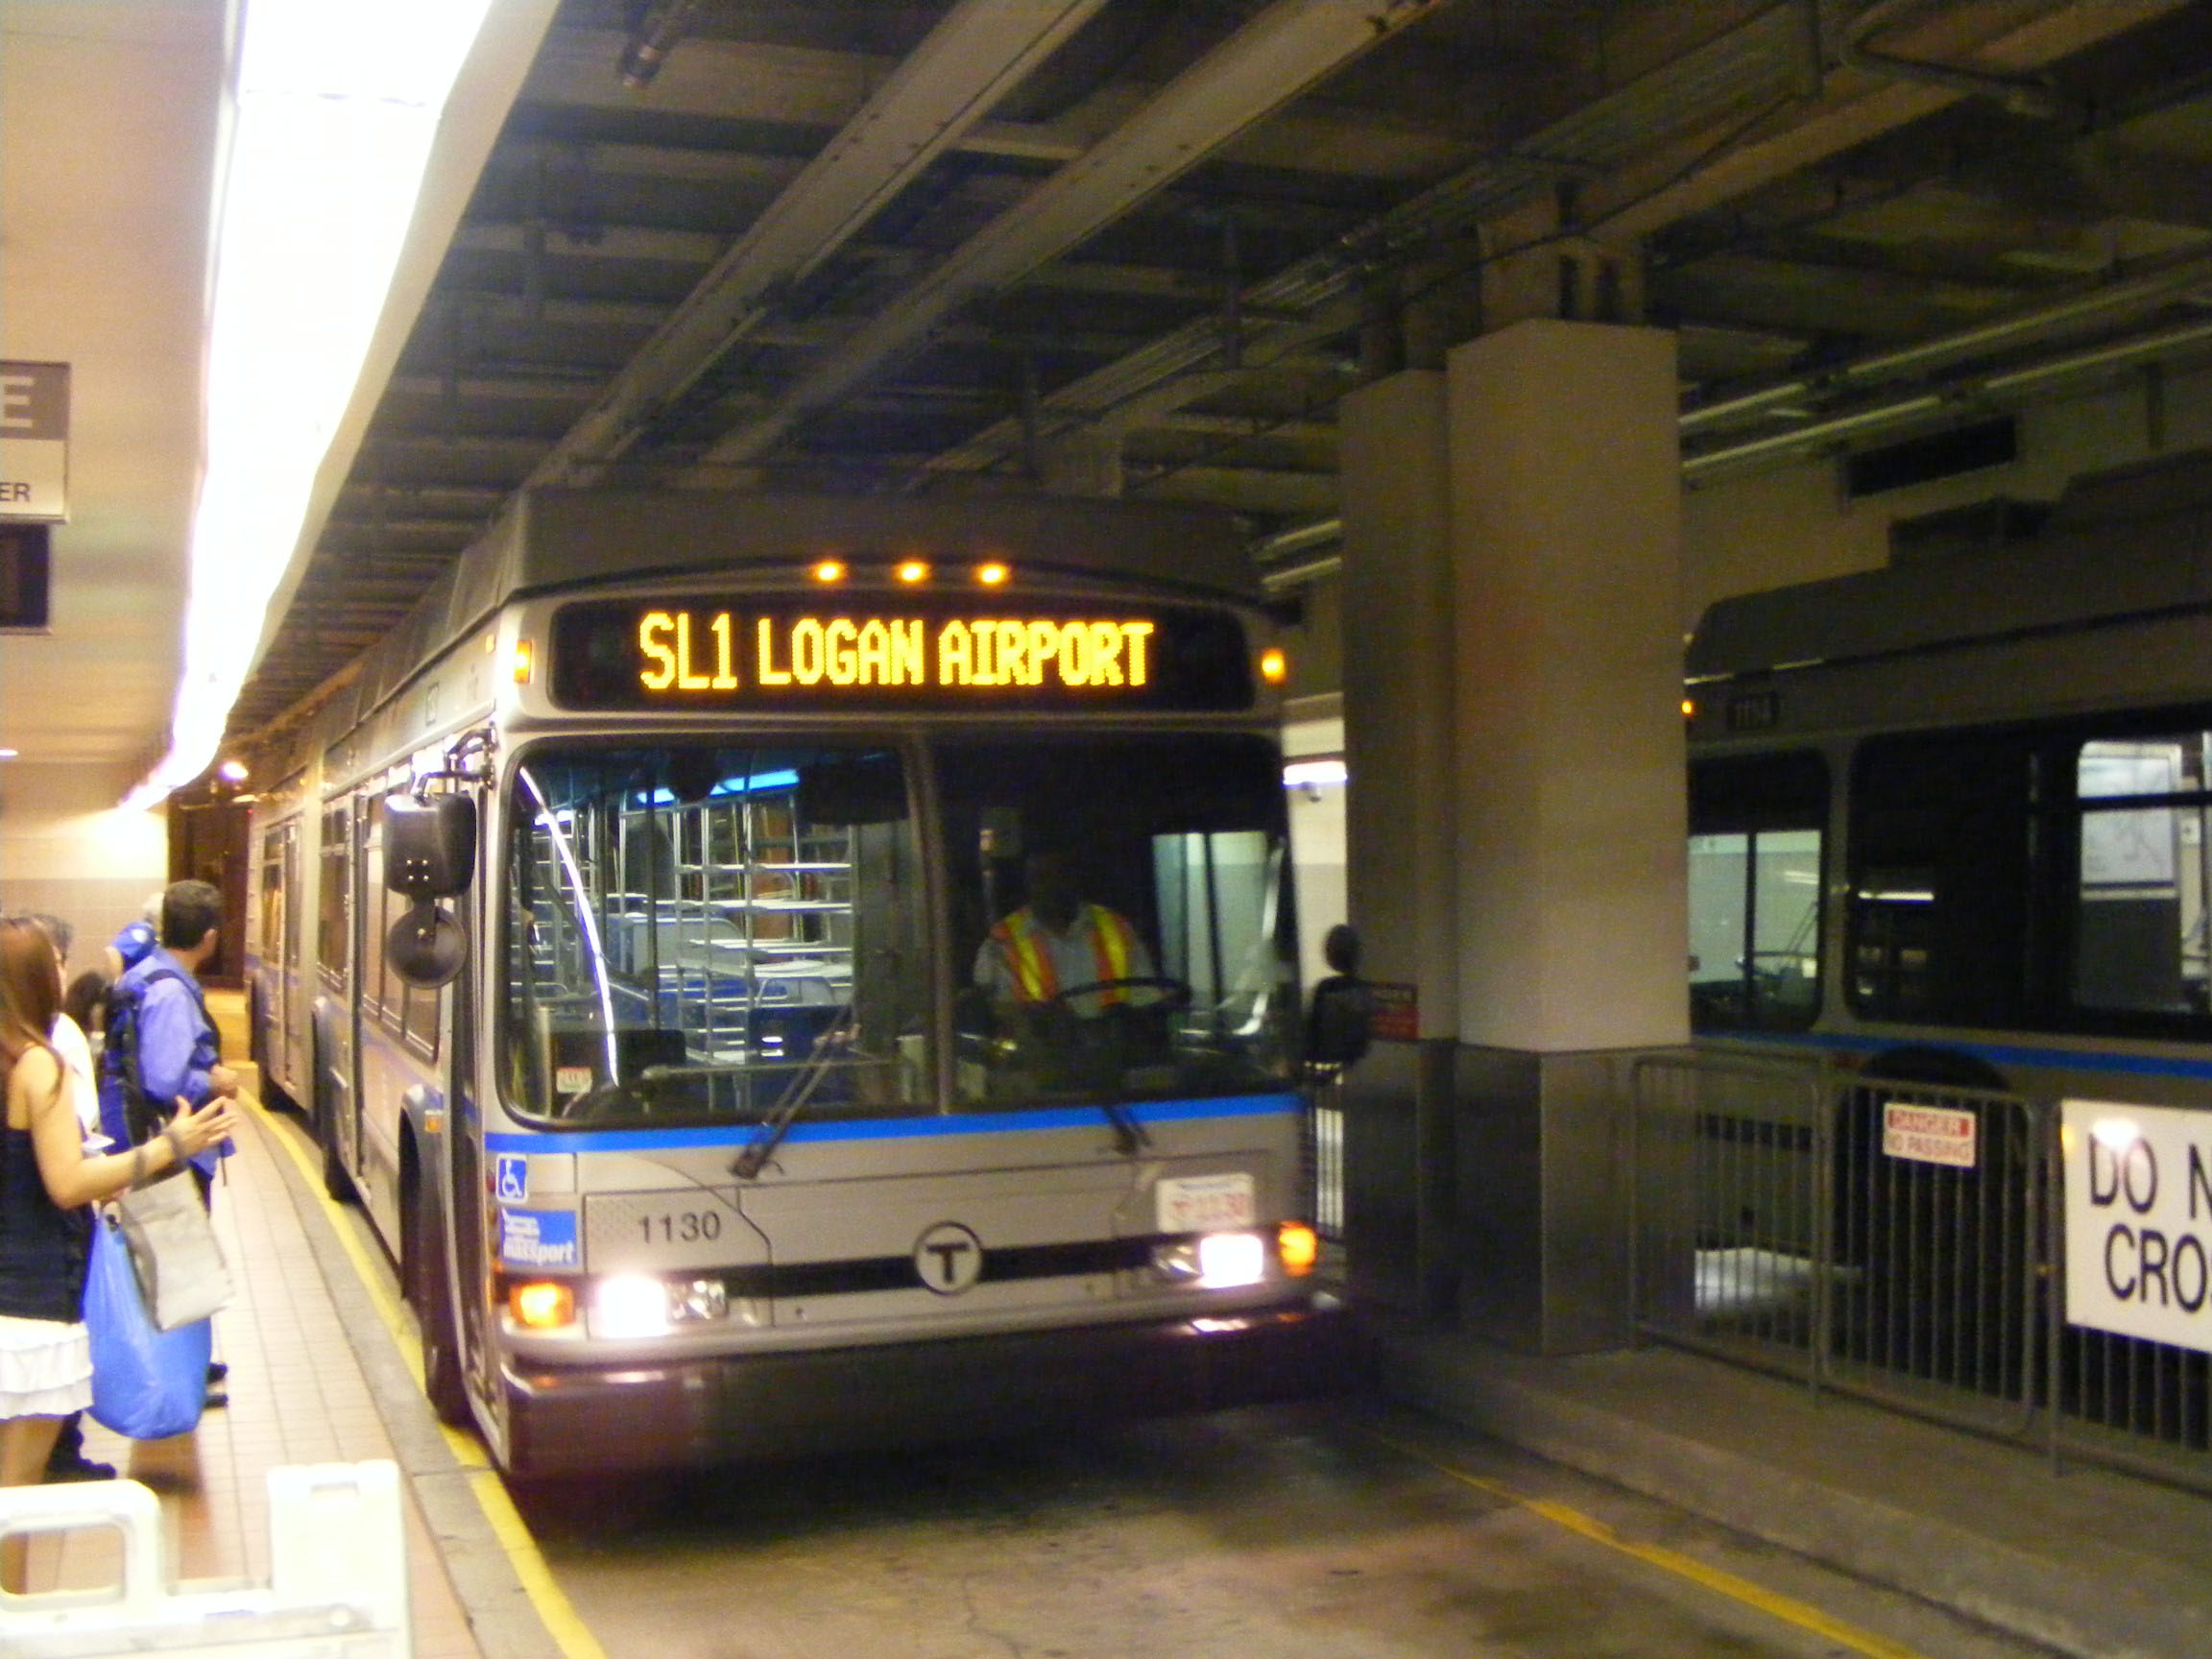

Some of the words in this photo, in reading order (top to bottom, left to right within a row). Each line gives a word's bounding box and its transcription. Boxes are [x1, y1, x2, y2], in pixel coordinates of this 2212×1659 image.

[639, 612, 738, 689] SL1
[757, 618, 925, 685] LOGAN
[938, 619, 1154, 686] AIRPORT
[2088, 1131, 2158, 1214] DO
[637, 1210, 720, 1244] 1130
[925, 1241, 970, 1284] T
[2104, 1222, 2208, 1313] CRO
